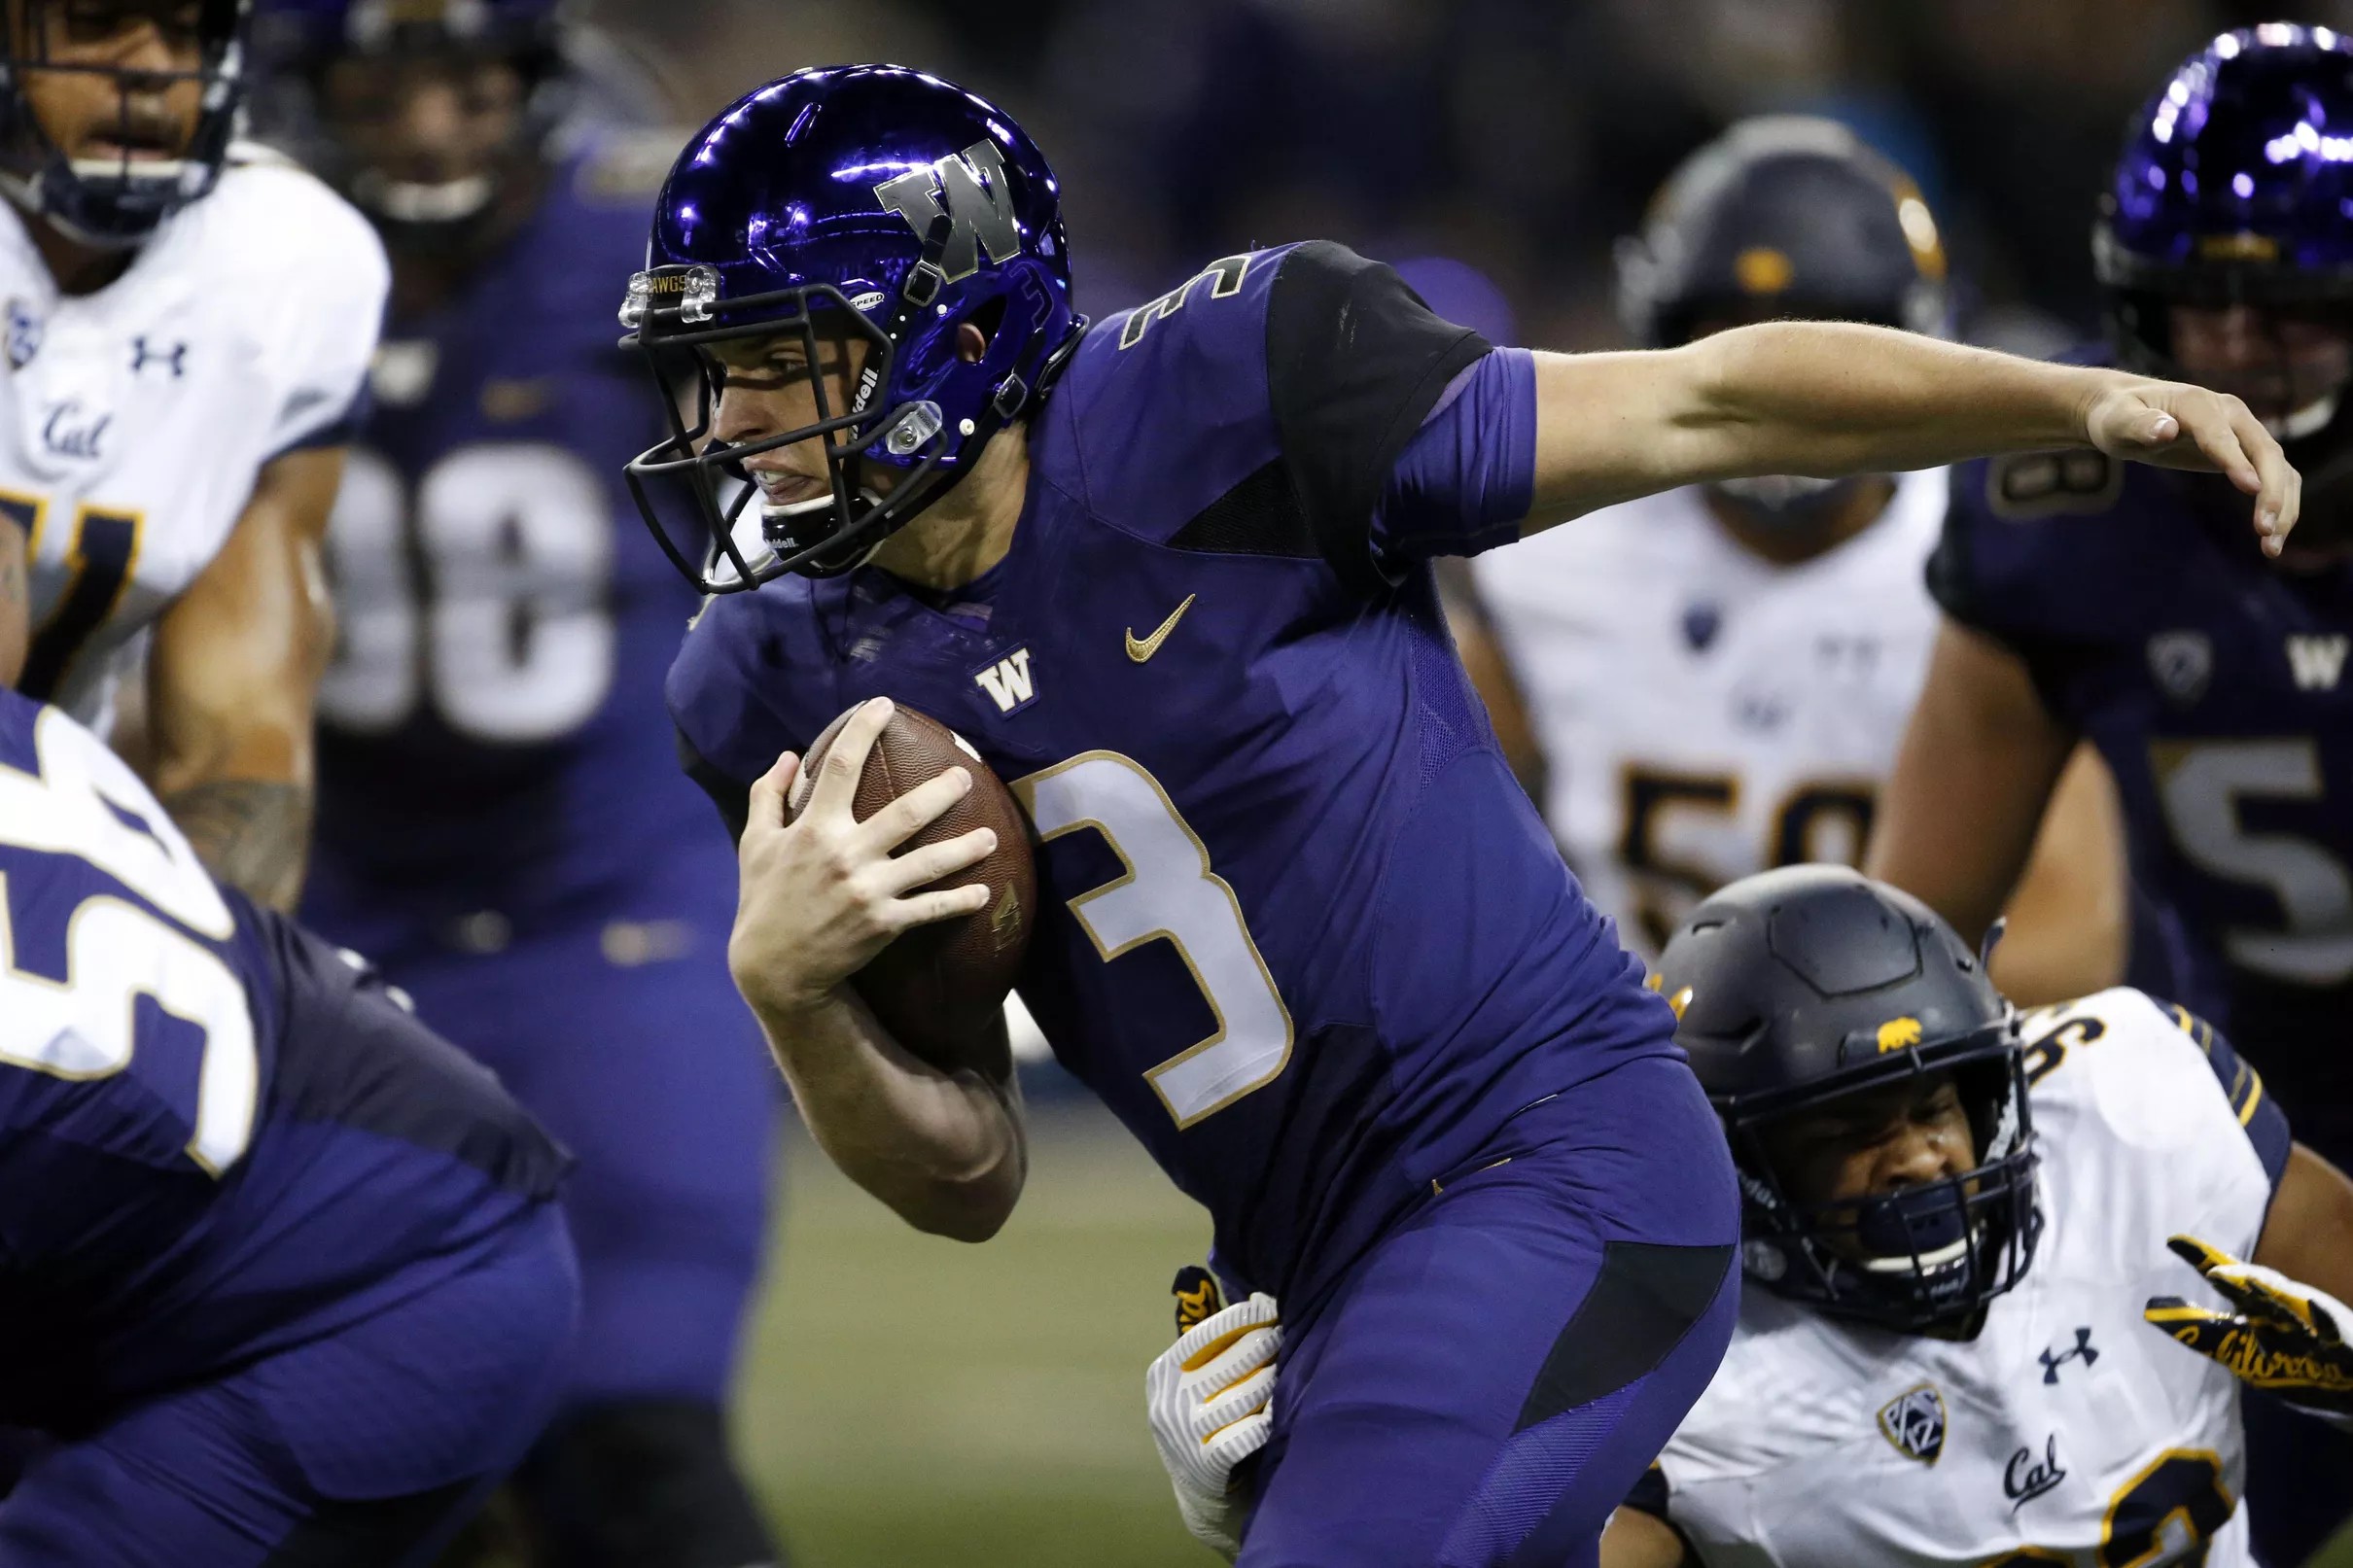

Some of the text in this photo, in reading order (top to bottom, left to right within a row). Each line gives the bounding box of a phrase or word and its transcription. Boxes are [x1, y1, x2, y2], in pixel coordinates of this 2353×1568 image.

[647, 275, 686, 294] AWGS
[974, 647, 1034, 713] W
[2287, 634, 2350, 693] W
[1007, 749, 1295, 1132] 3
[2003, 1433, 2067, 1514] Cal
